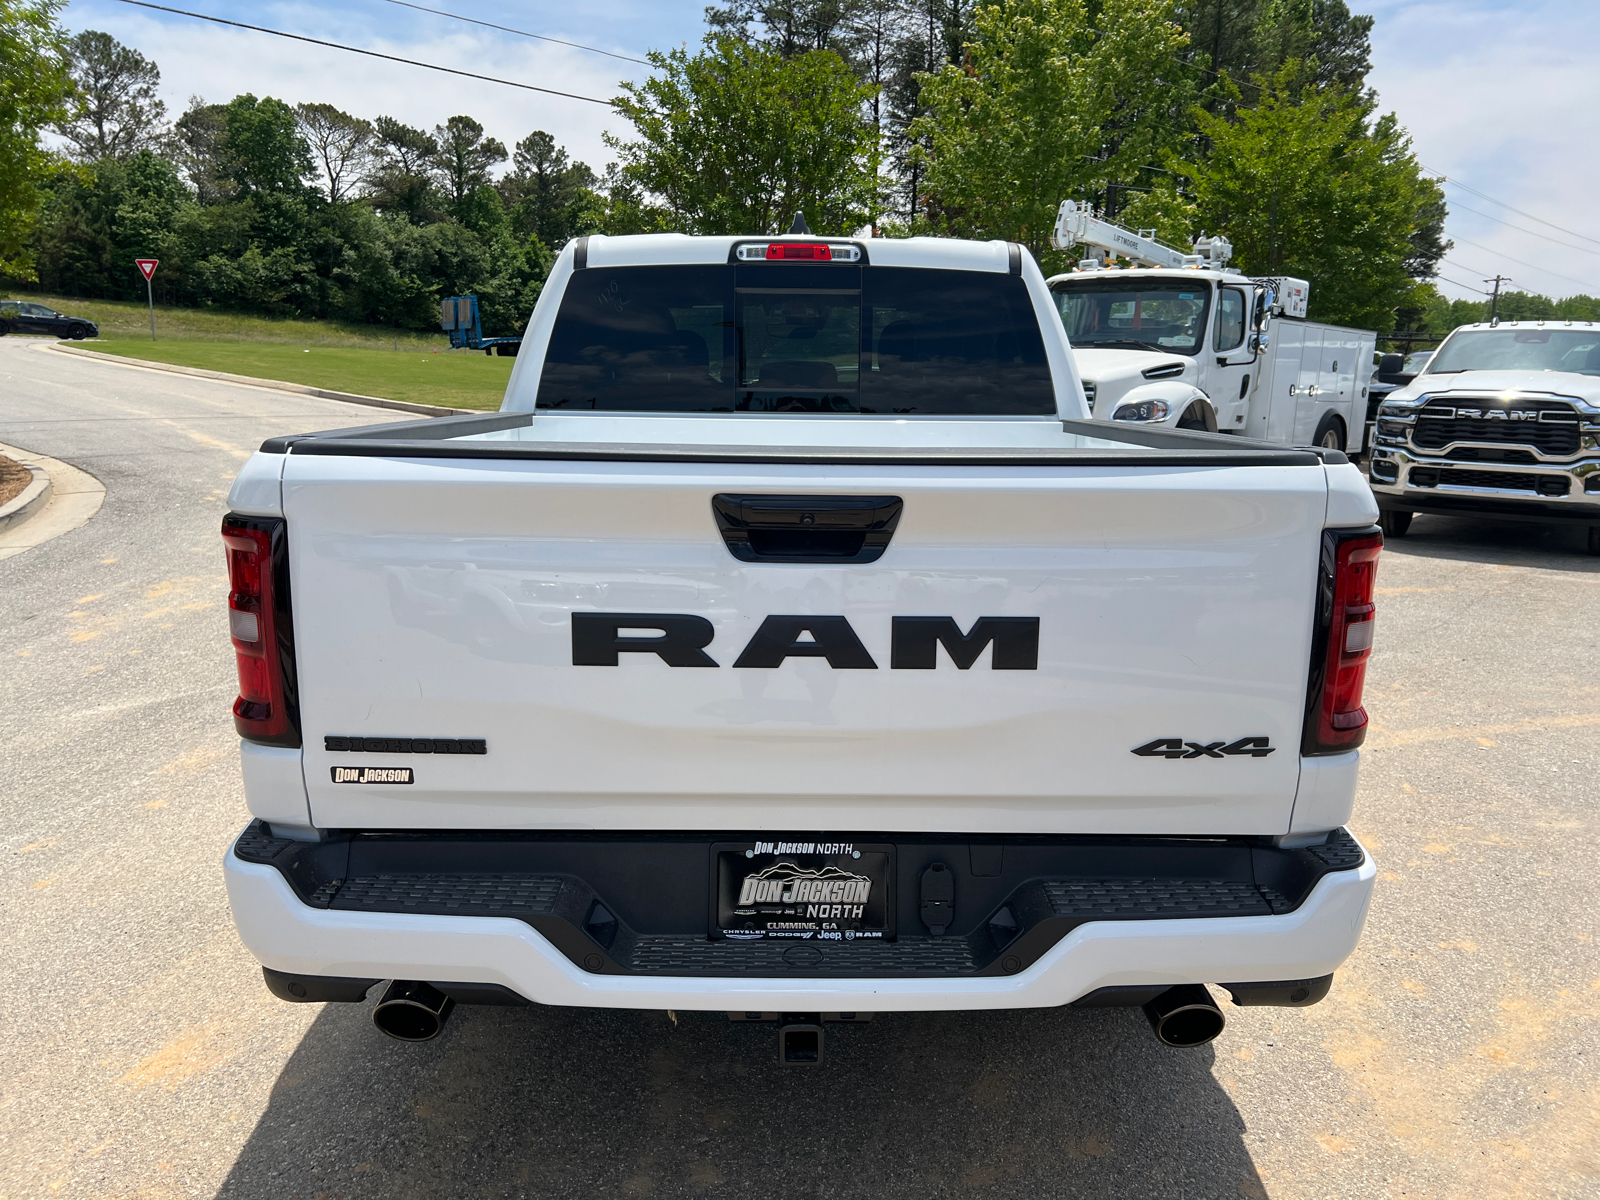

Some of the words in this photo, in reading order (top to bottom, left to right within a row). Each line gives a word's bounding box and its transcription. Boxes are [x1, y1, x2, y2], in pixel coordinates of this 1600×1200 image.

[1113, 234, 1139, 250] LIFTMOORE
[1457, 409, 1537, 421] RAM
[571, 612, 1040, 670] RAM
[1131, 737, 1276, 759] 4x4
[816, 843, 853, 855] NORTH
[806, 905, 864, 919] NORTH
[822, 922, 838, 930] GA
[817, 930, 841, 940] Jeep
